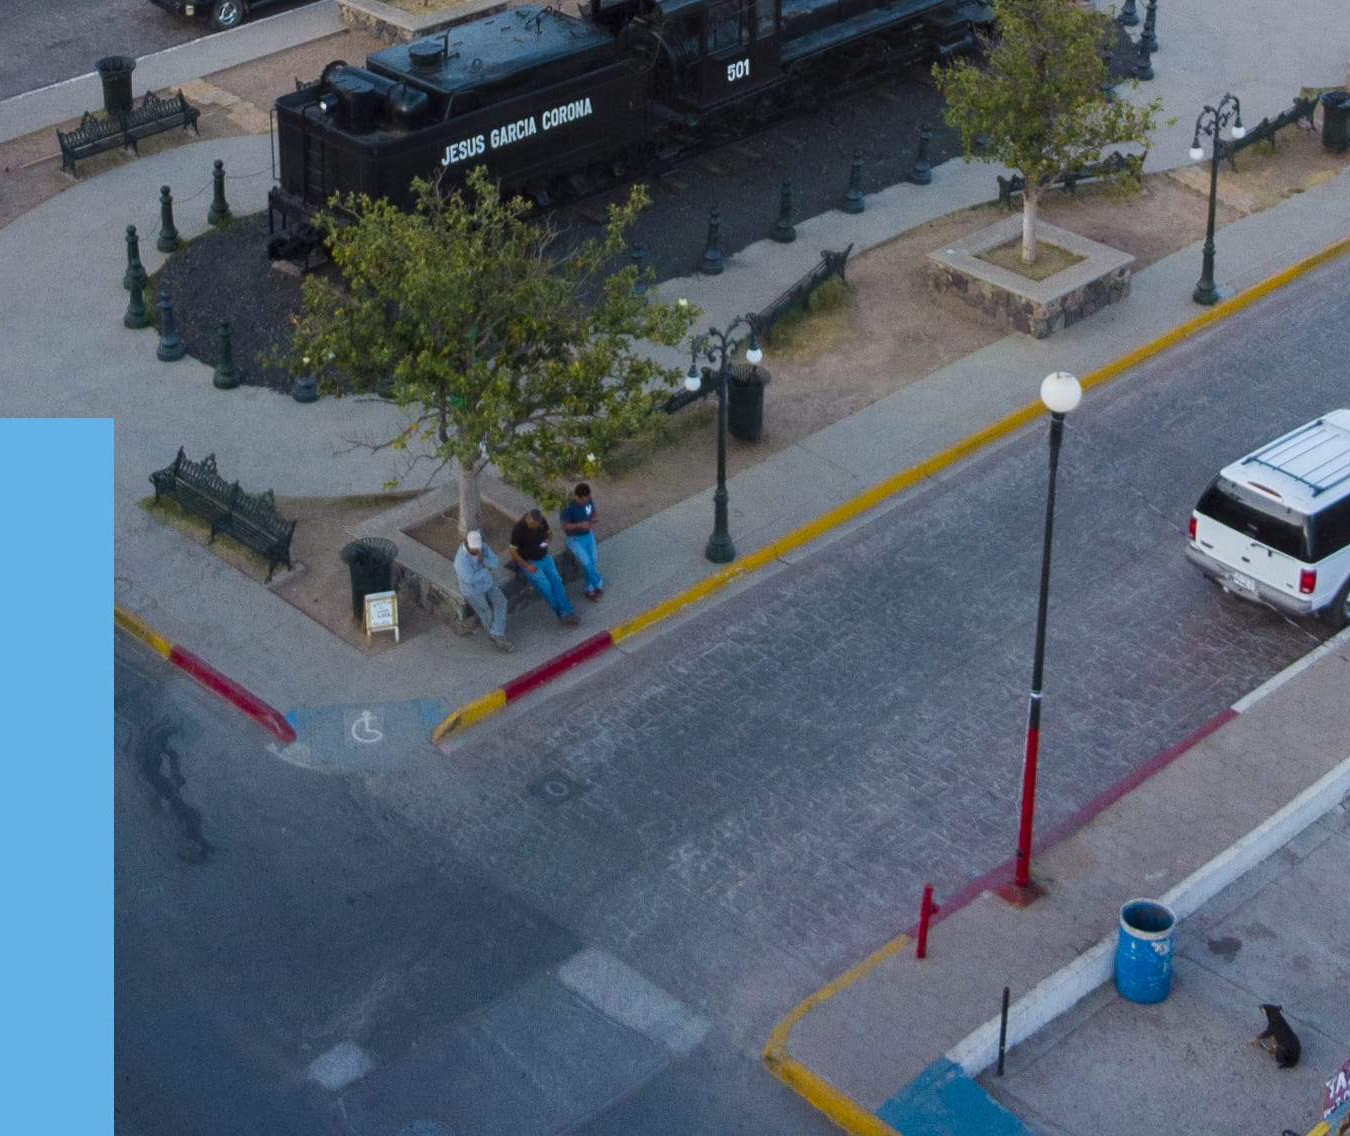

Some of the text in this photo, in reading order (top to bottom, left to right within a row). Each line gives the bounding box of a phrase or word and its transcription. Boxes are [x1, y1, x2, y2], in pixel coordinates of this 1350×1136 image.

[727, 58, 750, 82] 501
[441, 97, 593, 167] JESUS GARCIA CORONA
